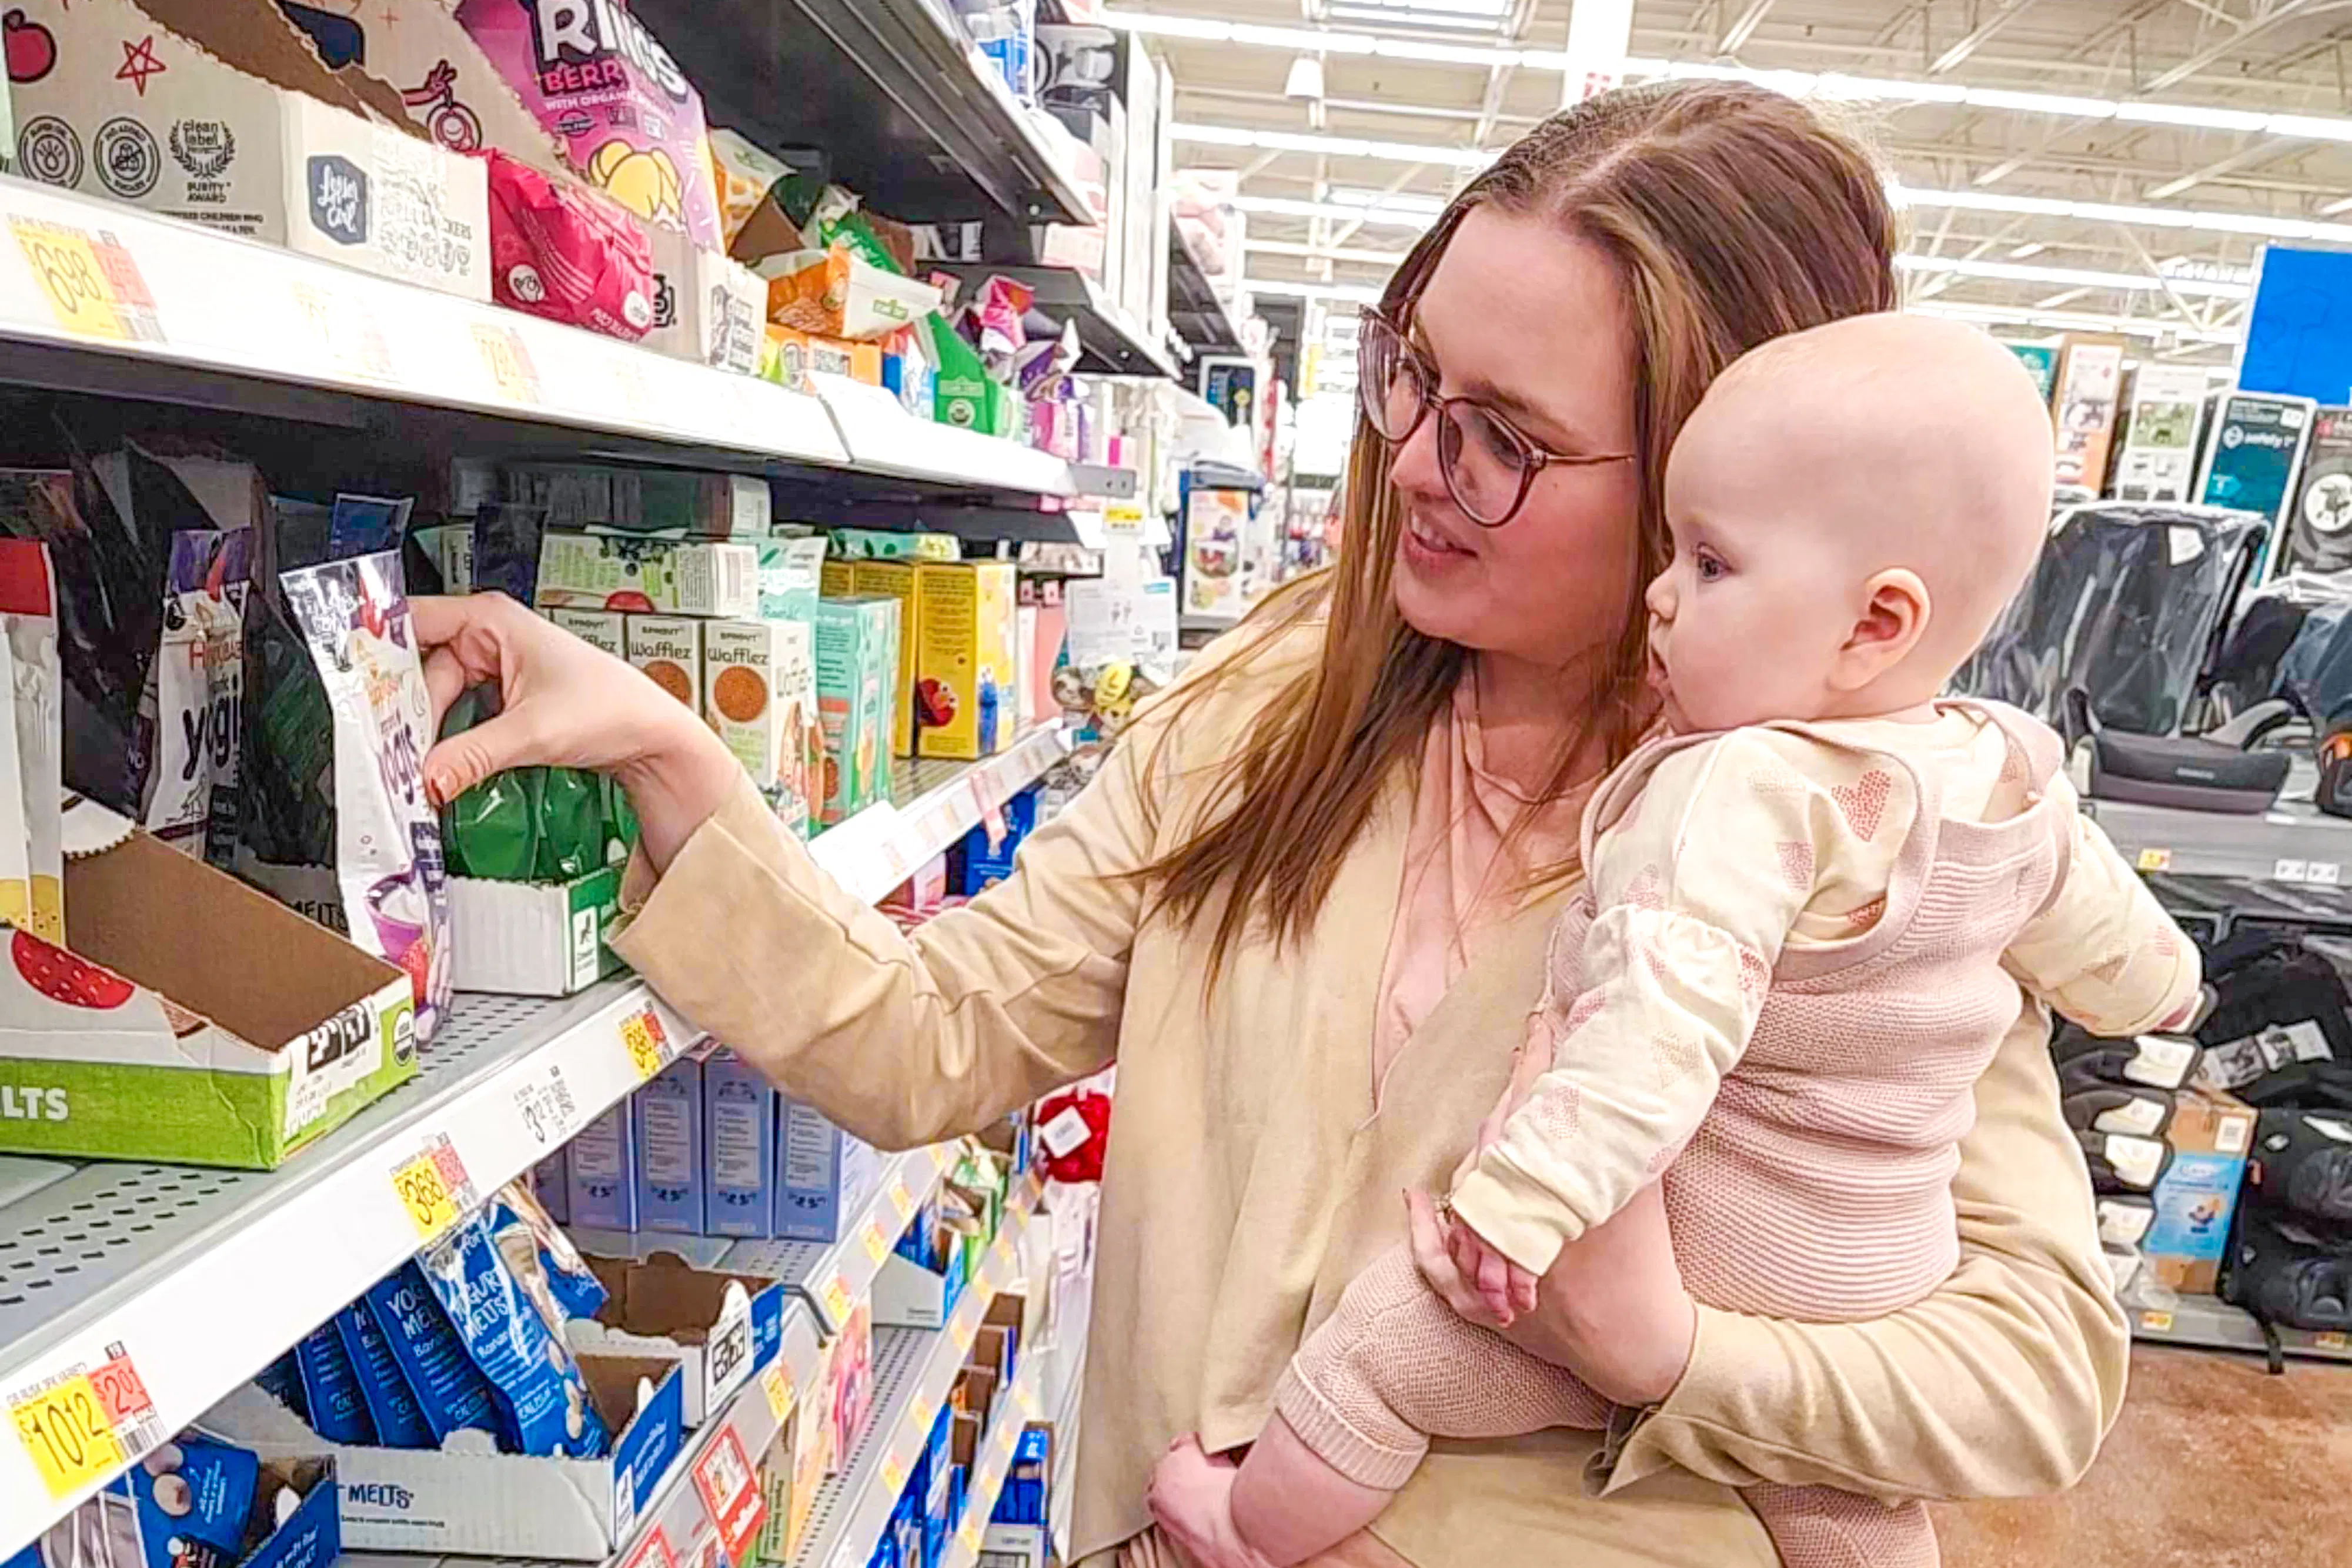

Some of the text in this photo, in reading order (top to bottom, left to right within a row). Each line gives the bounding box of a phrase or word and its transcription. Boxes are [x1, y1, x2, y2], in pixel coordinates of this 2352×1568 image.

[182, 119, 218, 132] clean
[185, 128, 218, 146] label
[630, 640, 692, 661] Wafflez
[707, 647, 770, 666] Wafflez
[348, 1483, 411, 1509] MELTS
